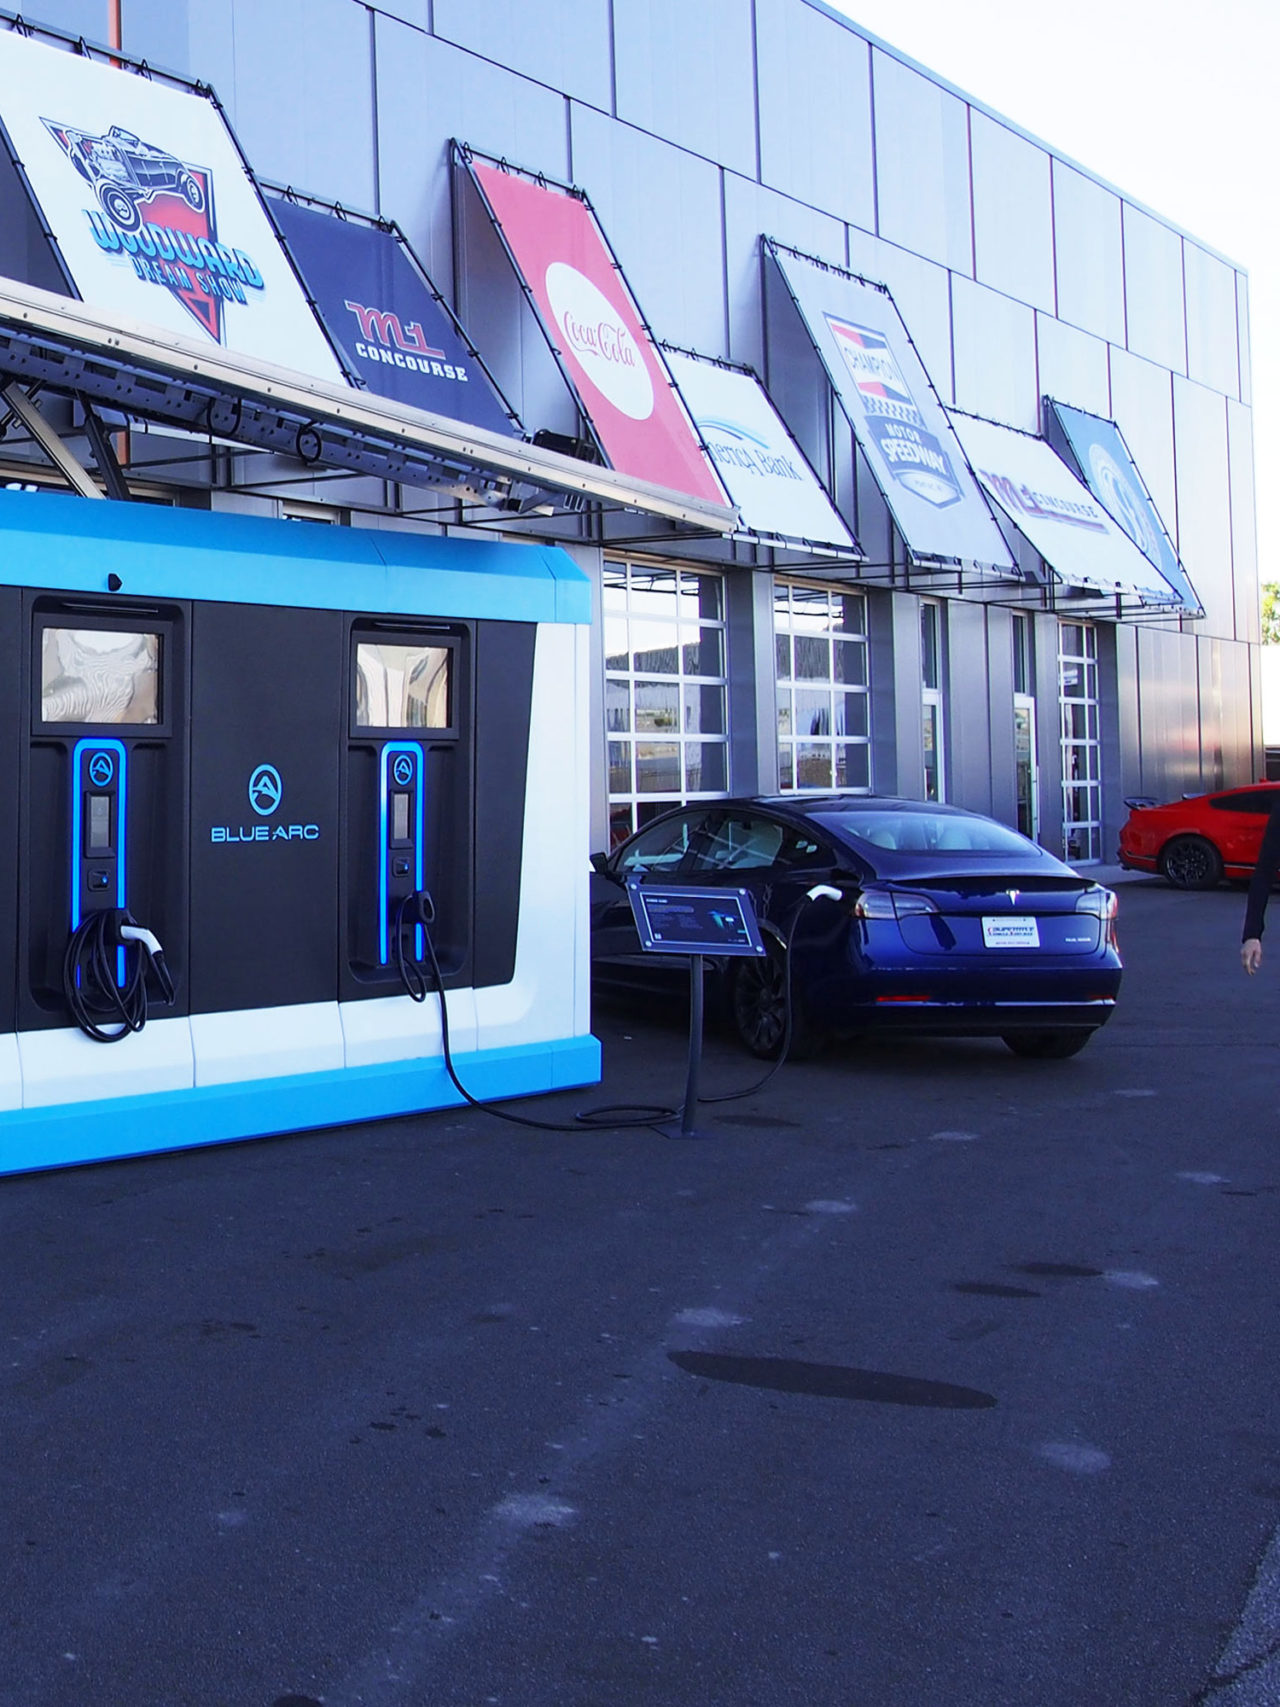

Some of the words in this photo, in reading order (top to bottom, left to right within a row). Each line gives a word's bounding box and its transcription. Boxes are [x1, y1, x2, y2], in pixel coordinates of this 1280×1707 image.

[131, 255, 193, 288] DREAM
[195, 272, 247, 305] SHOW
[563, 311, 635, 367] Coca-Cola
[355, 342, 468, 381] CONCOURSE
[885, 423, 922, 443] MOTOR
[754, 449, 803, 481] Bank
[880, 438, 947, 475] SPEEDWAY
[211, 826, 270, 843] BLUE
[272, 824, 319, 841] ARC
